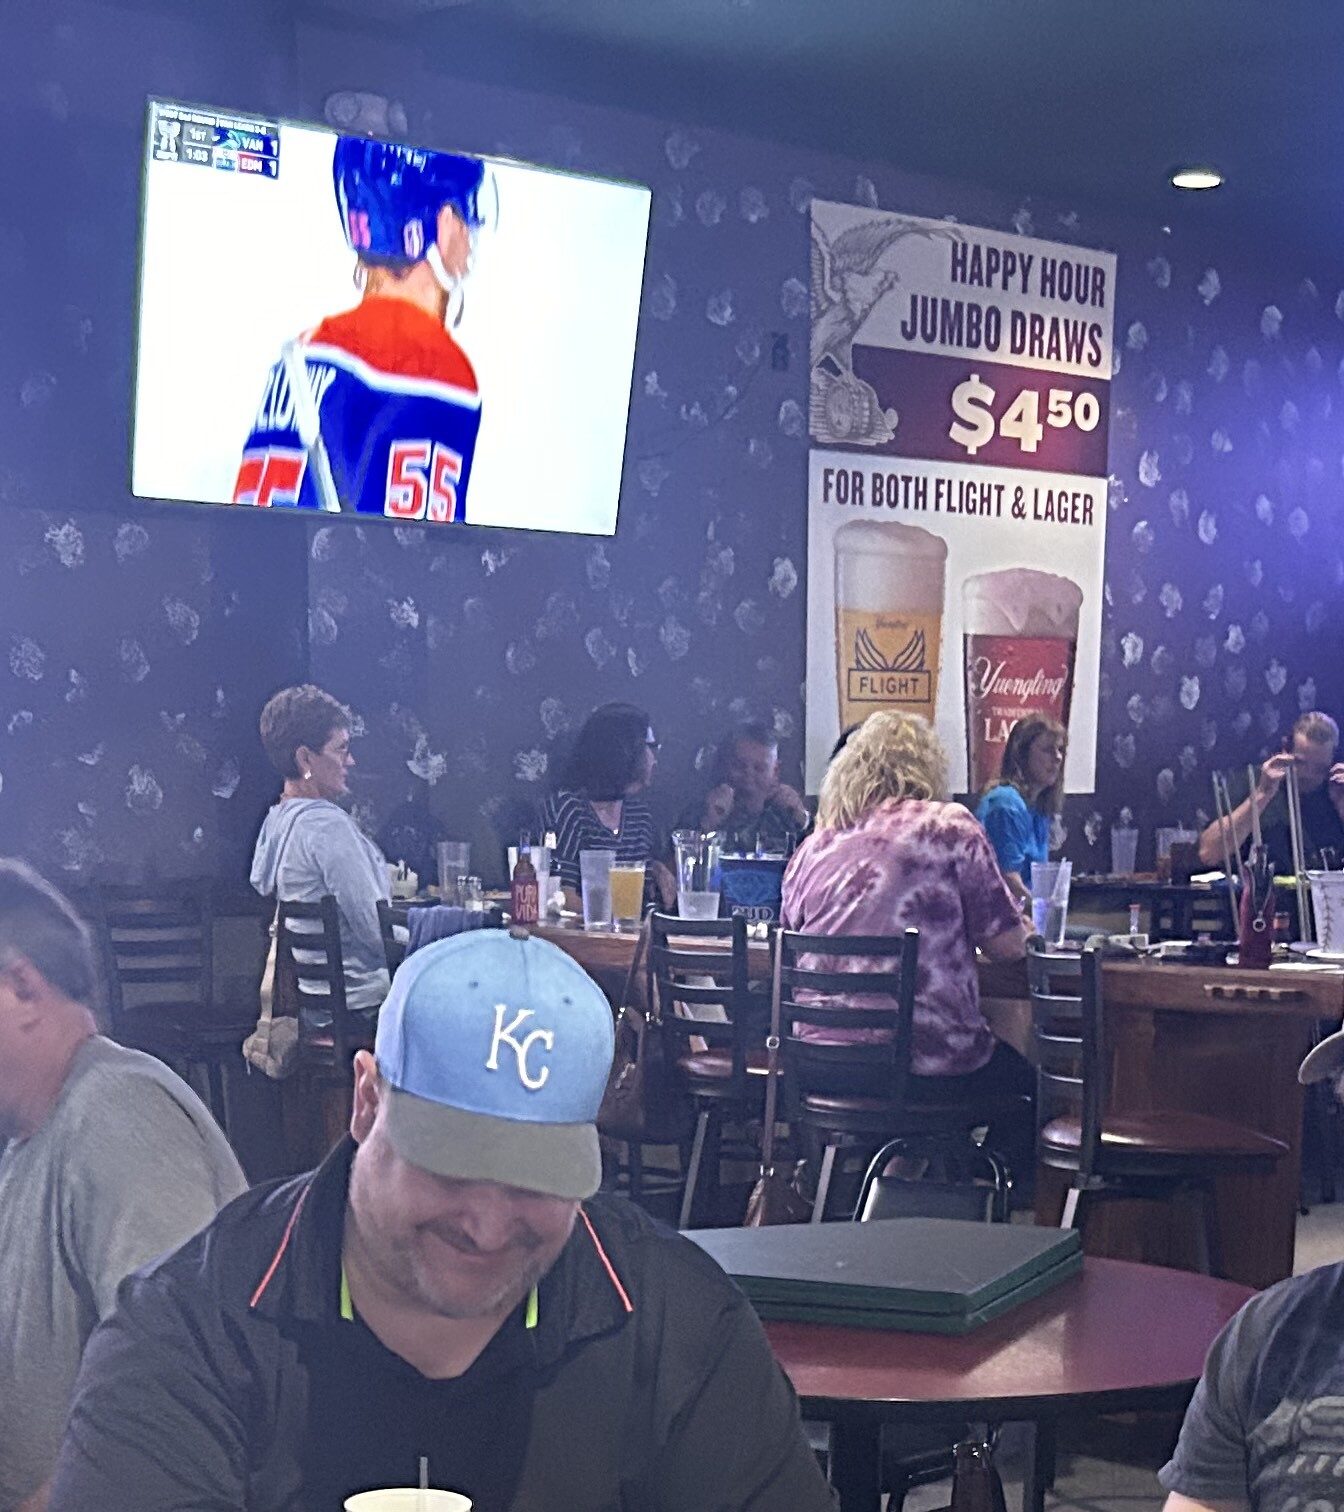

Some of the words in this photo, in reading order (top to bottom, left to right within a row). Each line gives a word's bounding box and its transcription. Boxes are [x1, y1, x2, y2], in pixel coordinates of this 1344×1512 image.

[241, 136, 264, 152] VAN
[241, 157, 263, 173] EDM
[951, 240, 1036, 295] HAPPY
[1040, 256, 1106, 309] HOUR
[901, 293, 1002, 353] JUMBO
[1010, 309, 1104, 368] DRAWS
[384, 440, 463, 522] 55
[822, 468, 864, 506] FOR
[871, 472, 928, 512] BOTH
[934, 478, 1006, 518] FLIGHT
[1011, 485, 1028, 520] &
[1033, 488, 1095, 527] LAGER
[859, 676, 920, 695] FLIGHT
[972, 656, 1069, 705] Yuengling
[485, 1003, 554, 1090] KC
